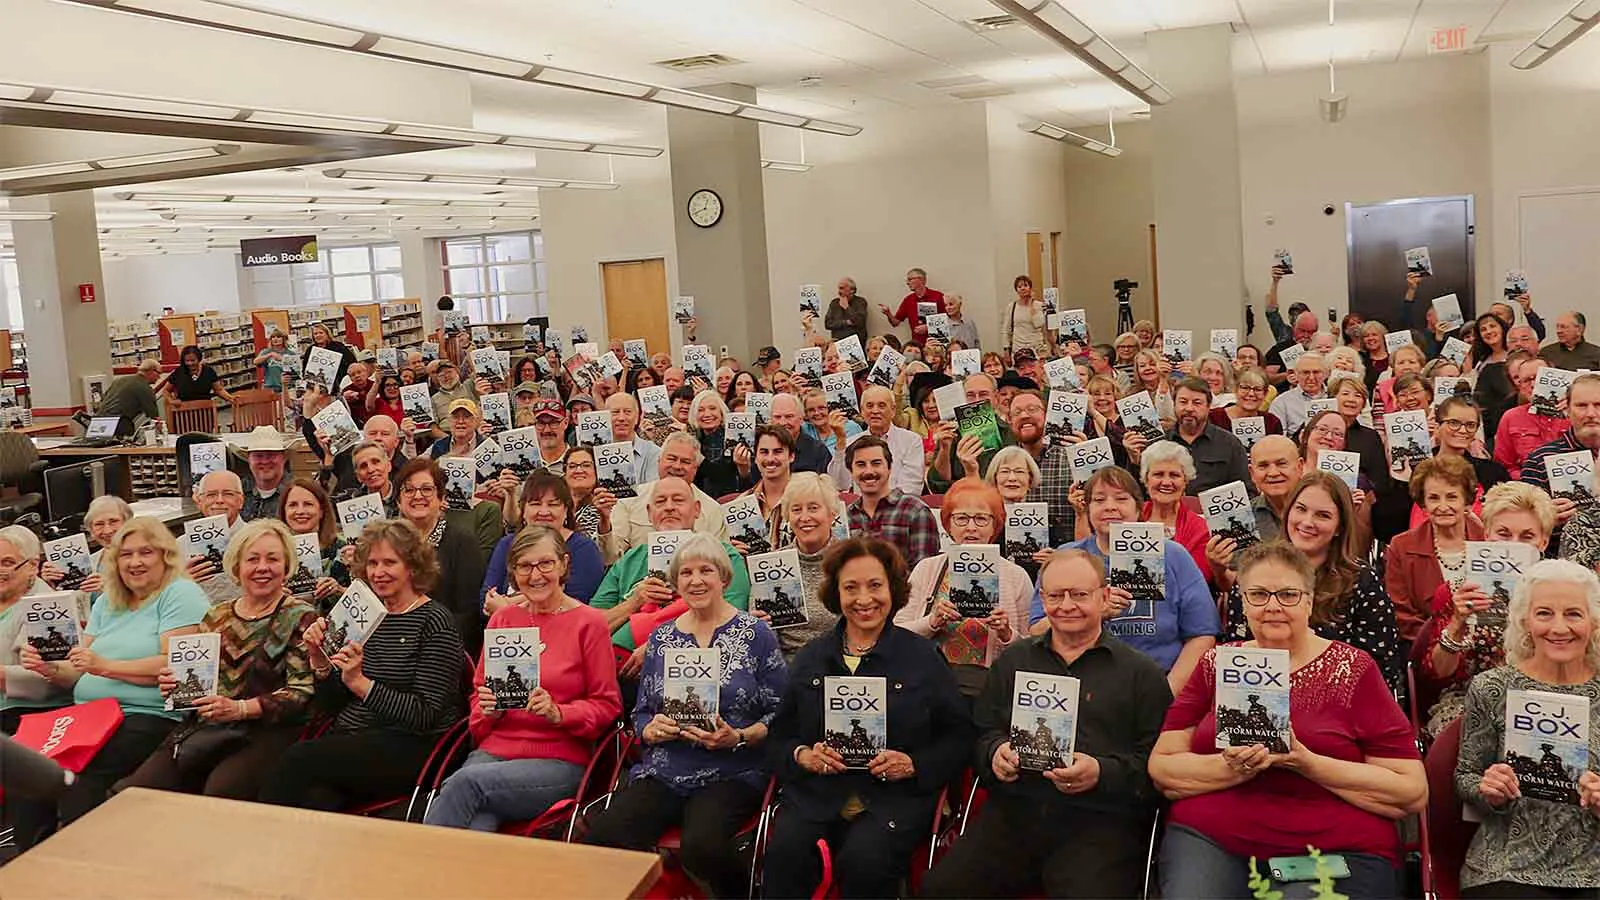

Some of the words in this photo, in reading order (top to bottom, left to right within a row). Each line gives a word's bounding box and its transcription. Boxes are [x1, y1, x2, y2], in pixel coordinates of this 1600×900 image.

[1436, 26, 1468, 49] EXIT
[247, 254, 278, 264] Audio
[282, 252, 314, 262] Books
[312, 355, 335, 367] BOX
[474, 355, 495, 364] BOX
[685, 353, 707, 362] BOX
[798, 356, 820, 364] BOX
[1050, 365, 1073, 377] BOX
[825, 380, 850, 392] BOX
[1539, 377, 1570, 388] BOX
[404, 390, 426, 400] BOX
[643, 393, 667, 403] BOX
[1052, 402, 1083, 414] BOX
[1122, 401, 1150, 416] BOX
[319, 410, 344, 428] BOX
[962, 413, 993, 430] BOX
[581, 421, 608, 431] BOX
[1235, 427, 1262, 436] BOX
[1392, 422, 1425, 434] BOX
[504, 439, 535, 451] BOX
[193, 453, 220, 462] BOX
[476, 448, 498, 468] BOX
[598, 454, 629, 465] BOX
[1074, 451, 1110, 467] BOX
[1321, 461, 1354, 472] BOX
[1552, 463, 1591, 478] BOX
[1208, 496, 1246, 516] BOX
[344, 508, 379, 523] BOX
[726, 507, 758, 524] BOX
[1009, 517, 1045, 527] BOX
[190, 529, 225, 542] BOX
[297, 545, 315, 556] OX
[652, 544, 676, 555] BO
[1115, 540, 1160, 552] BOX
[50, 547, 83, 561] BOX
[953, 562, 995, 574] BOX
[1472, 559, 1522, 574] BOX
[754, 566, 795, 582] BOX
[27, 609, 69, 622] BOX
[342, 595, 368, 630] BOX
[172, 649, 209, 663] BOX
[489, 646, 532, 658] BOX
[668, 666, 712, 678] BOX
[1224, 668, 1282, 688] BOX
[830, 698, 879, 711] BOX
[1018, 692, 1067, 712] BOX
[1224, 726, 1252, 736] STORM
[1255, 728, 1282, 738] WATCH
[1514, 715, 1581, 739] BOX
[1518, 773, 1544, 784] TORM
